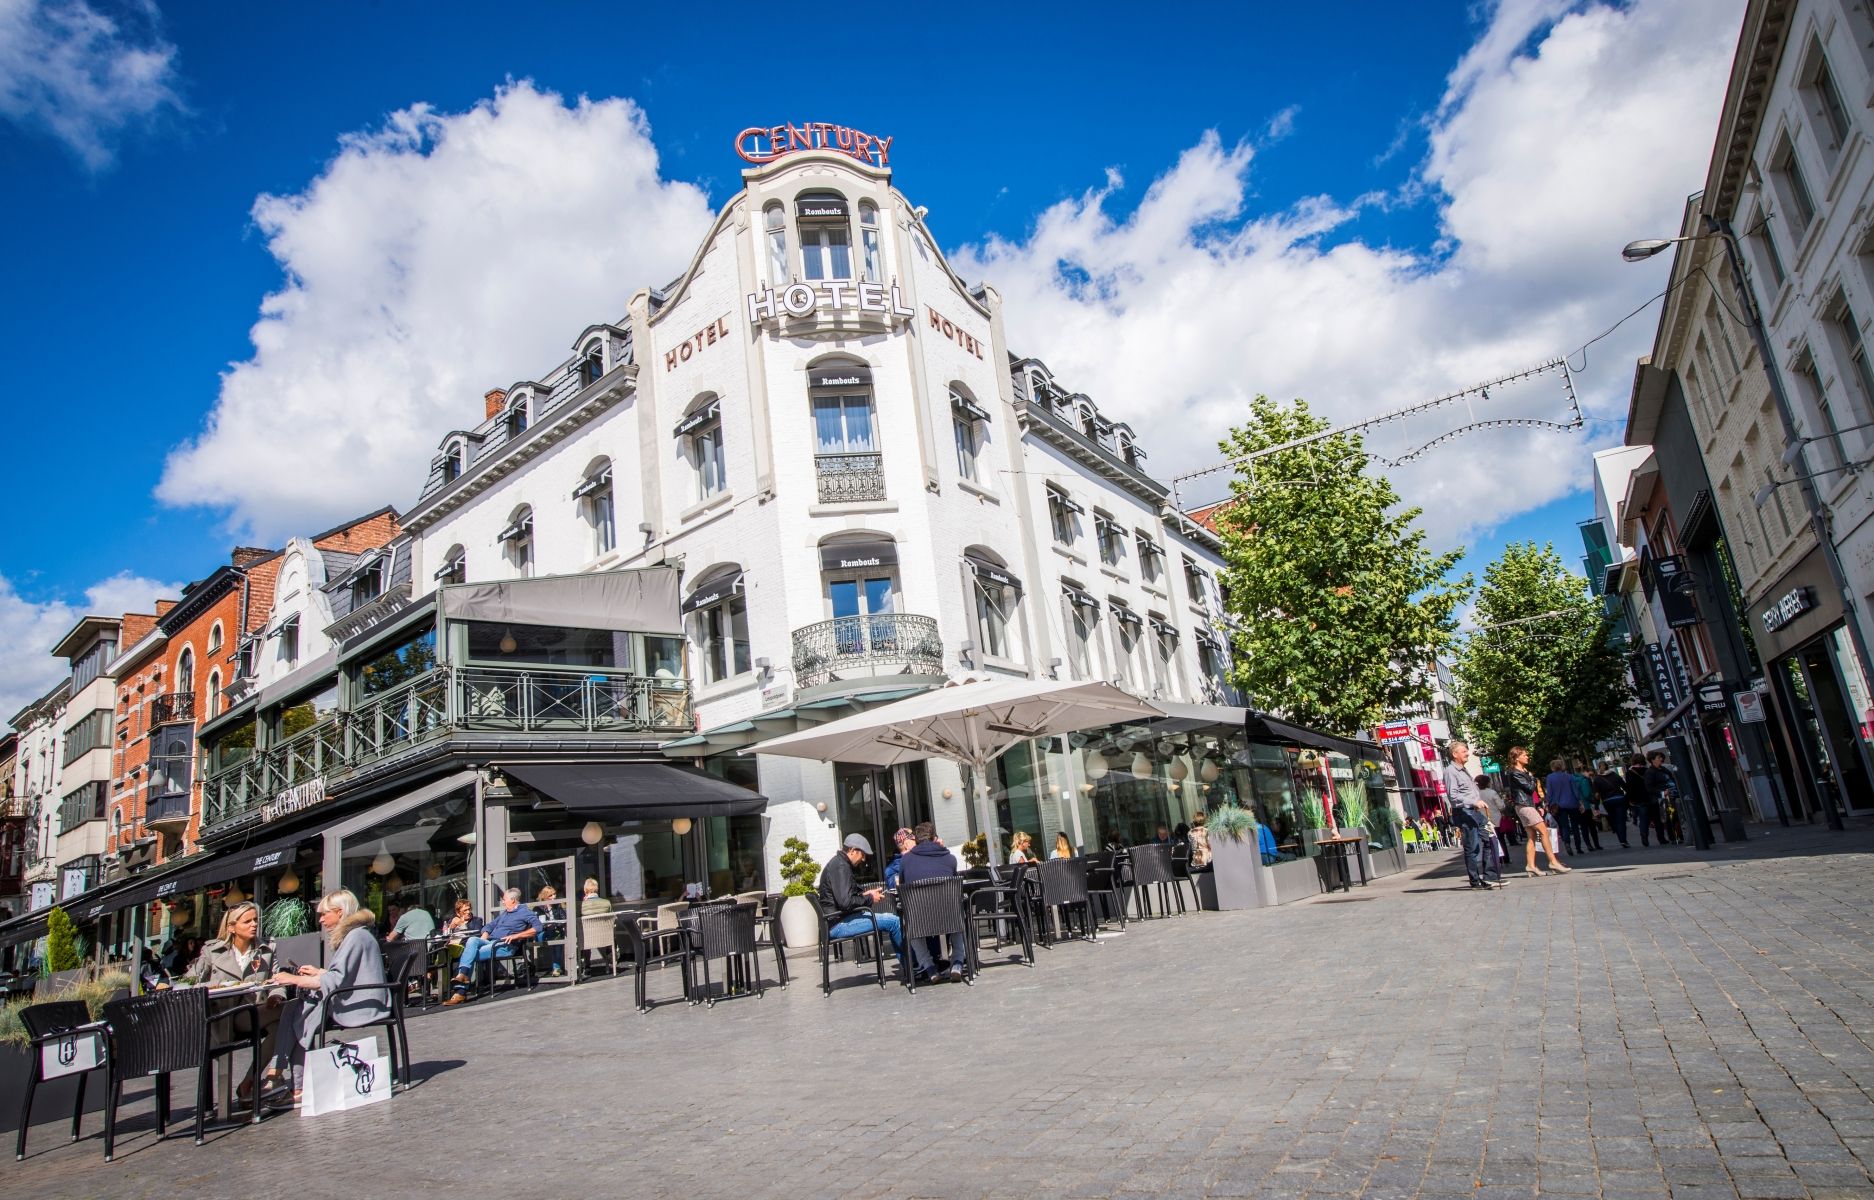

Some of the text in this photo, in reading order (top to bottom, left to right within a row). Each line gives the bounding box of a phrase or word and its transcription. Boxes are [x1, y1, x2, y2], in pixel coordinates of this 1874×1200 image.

[735, 121, 893, 164] CENTURY
[804, 208, 842, 216] Rombouts
[747, 281, 915, 324] HOTEL
[664, 316, 730, 372] HOTEL
[928, 306, 984, 360] HOTEL
[822, 376, 860, 386] Rombouts
[840, 557, 880, 568] Rombouts
[1704, 702, 1726, 710] RAW
